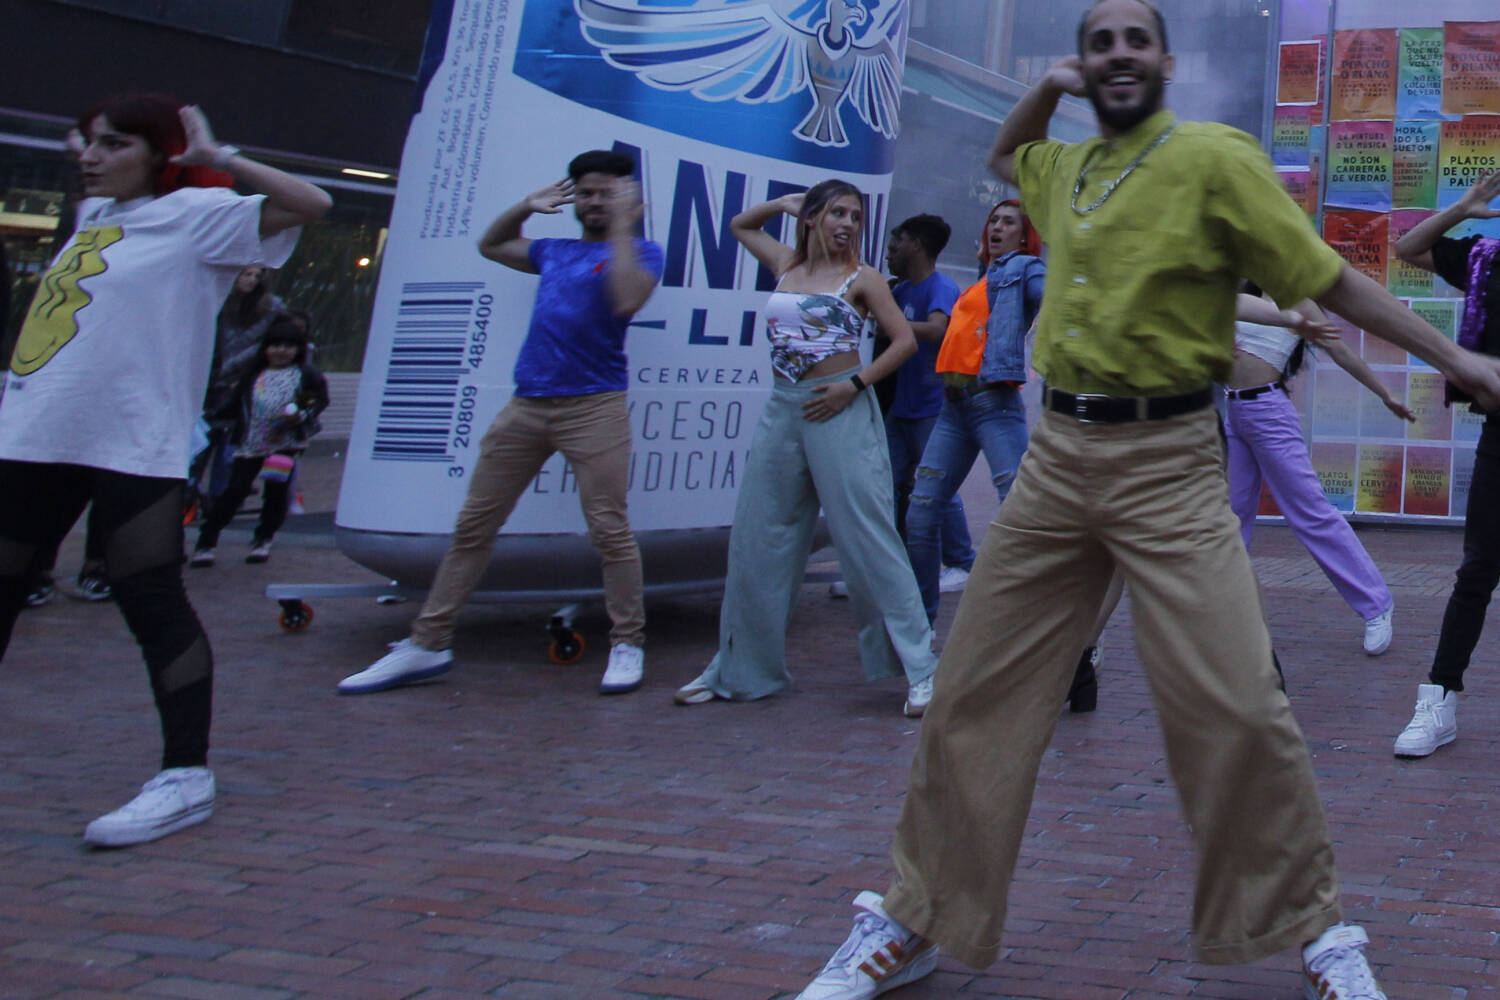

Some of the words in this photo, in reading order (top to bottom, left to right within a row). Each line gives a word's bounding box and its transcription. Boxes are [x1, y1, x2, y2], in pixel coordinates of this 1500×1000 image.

[496, 0, 510, 22] 330
[491, 25, 505, 54] neto
[479, 57, 500, 121] Contenido
[443, 180, 463, 238] Industria
[469, 33, 489, 98] Contenido
[470, 124, 488, 183] volumen.
[1450, 156, 1496, 165] PLATOS
[1336, 165, 1387, 173] CARRERAS
[1348, 174, 1390, 182] VERDAD.
[1443, 167, 1457, 176] DE
[1450, 177, 1476, 187] PAÍS
[466, 186, 476, 203] en
[419, 174, 438, 239] Producida
[431, 201, 445, 238] Norte
[467, 293, 494, 369] 485400
[638, 367, 761, 384] CERVEZA
[452, 385, 477, 448] 20809
[447, 466, 464, 478] 3
[1325, 479, 1352, 487] OTROS
